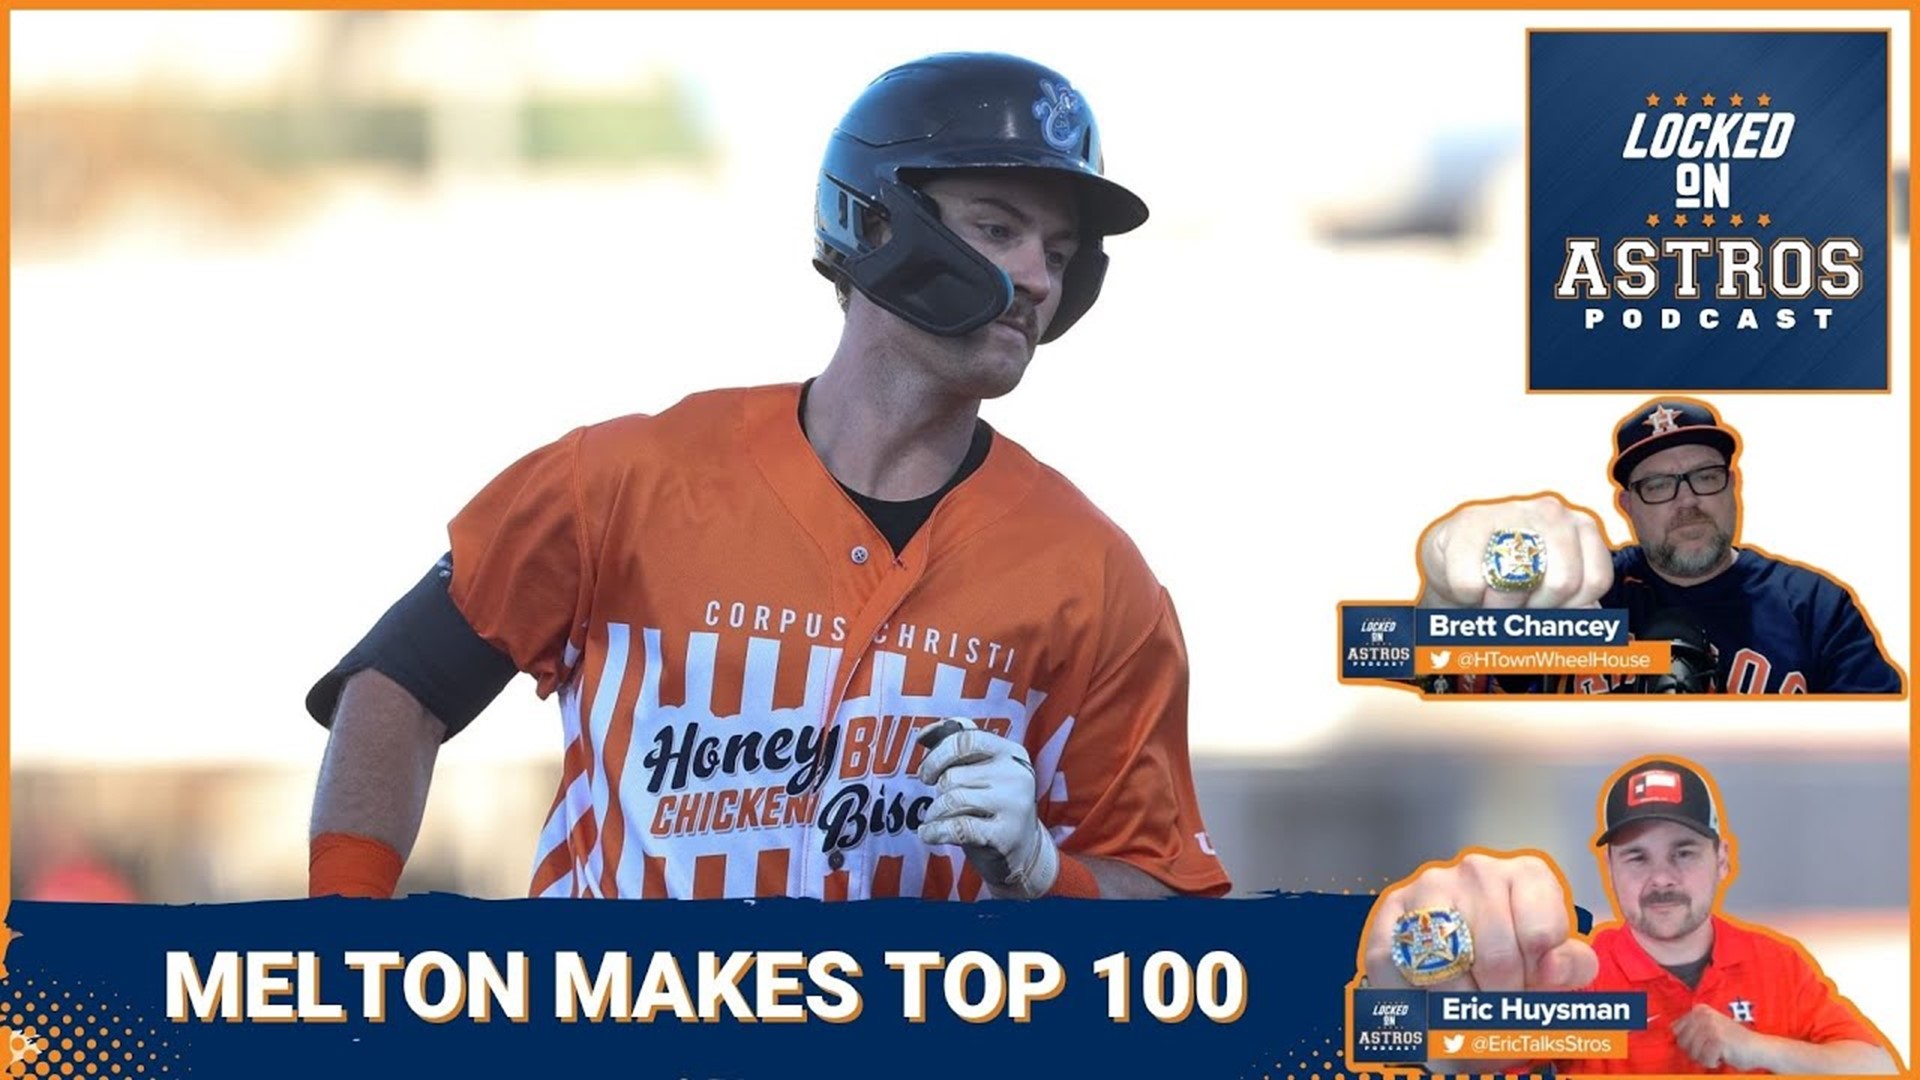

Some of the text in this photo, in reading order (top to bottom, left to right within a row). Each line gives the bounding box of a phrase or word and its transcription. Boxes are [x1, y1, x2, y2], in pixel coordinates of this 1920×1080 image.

[704, 600, 846, 641] CORPUS
[643, 715, 1013, 796] Honey BUT
[649, 782, 935, 853] CHICKEN Bisc
